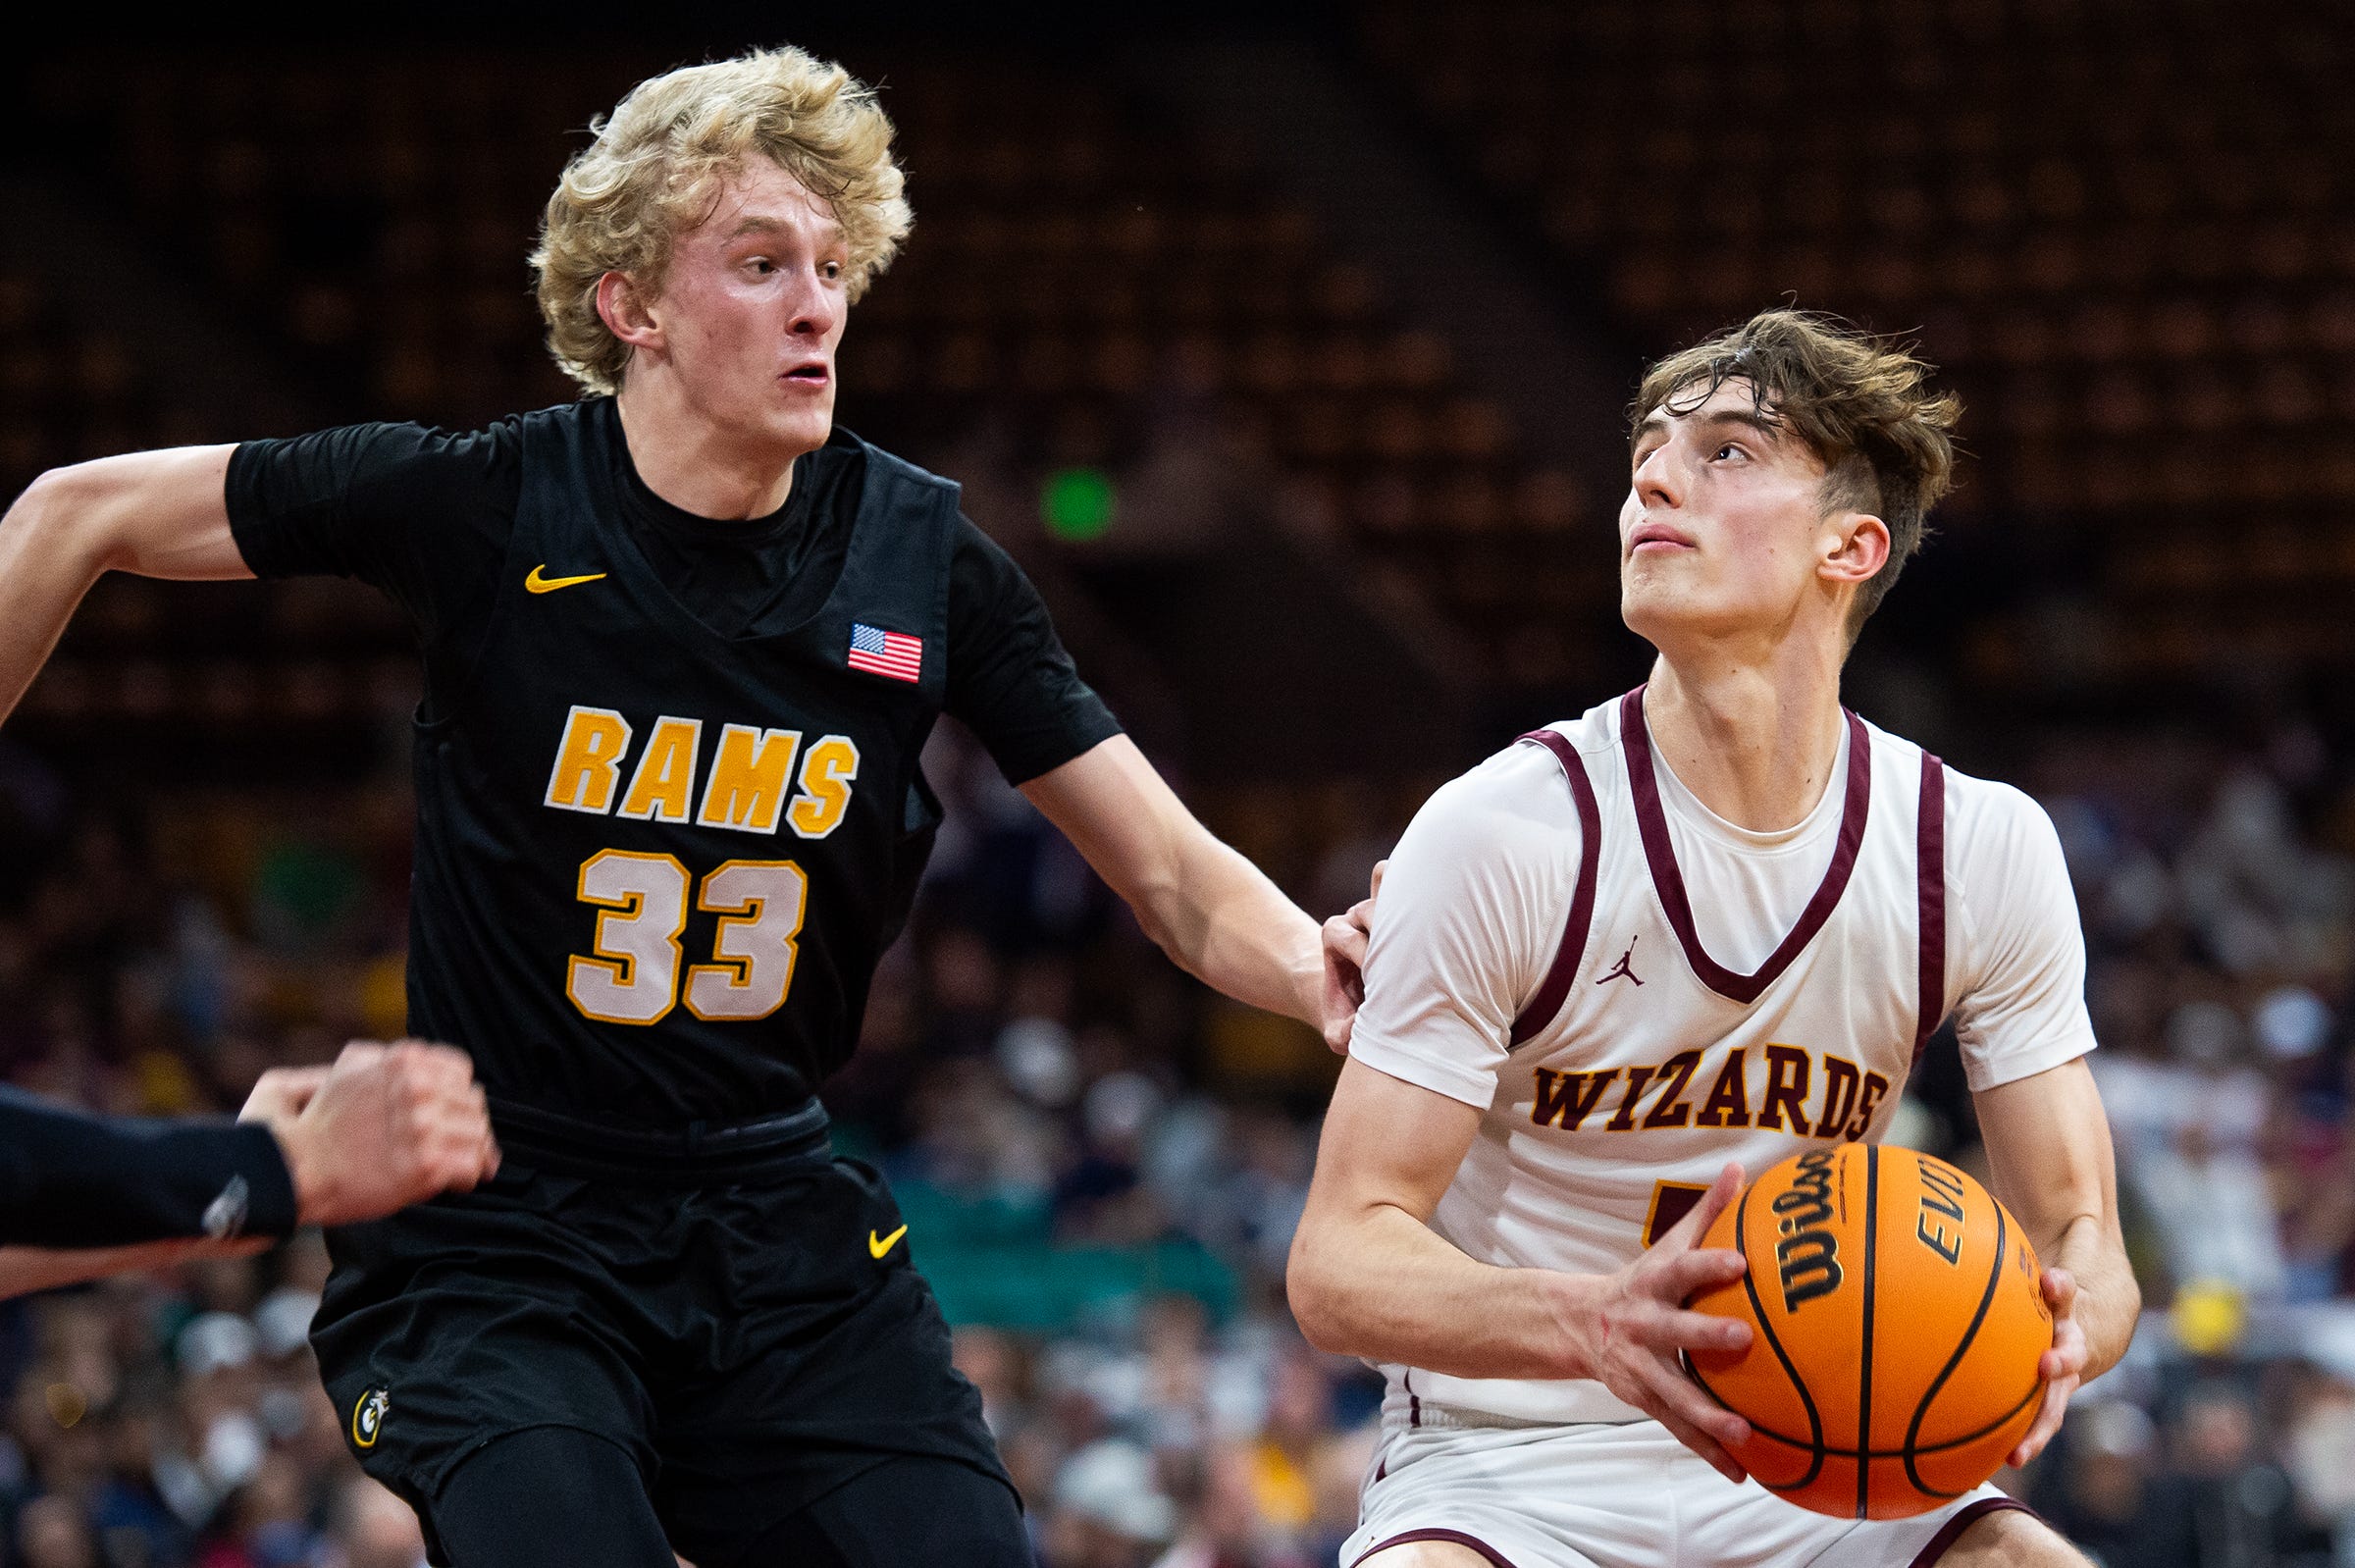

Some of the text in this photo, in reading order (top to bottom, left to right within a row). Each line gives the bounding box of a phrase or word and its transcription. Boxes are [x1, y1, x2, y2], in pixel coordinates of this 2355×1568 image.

[544, 706, 861, 840] RAMS
[566, 848, 808, 1027] 33
[1531, 1042, 1889, 1143] WIZARDS
[1771, 1149, 1844, 1315] Wilso
